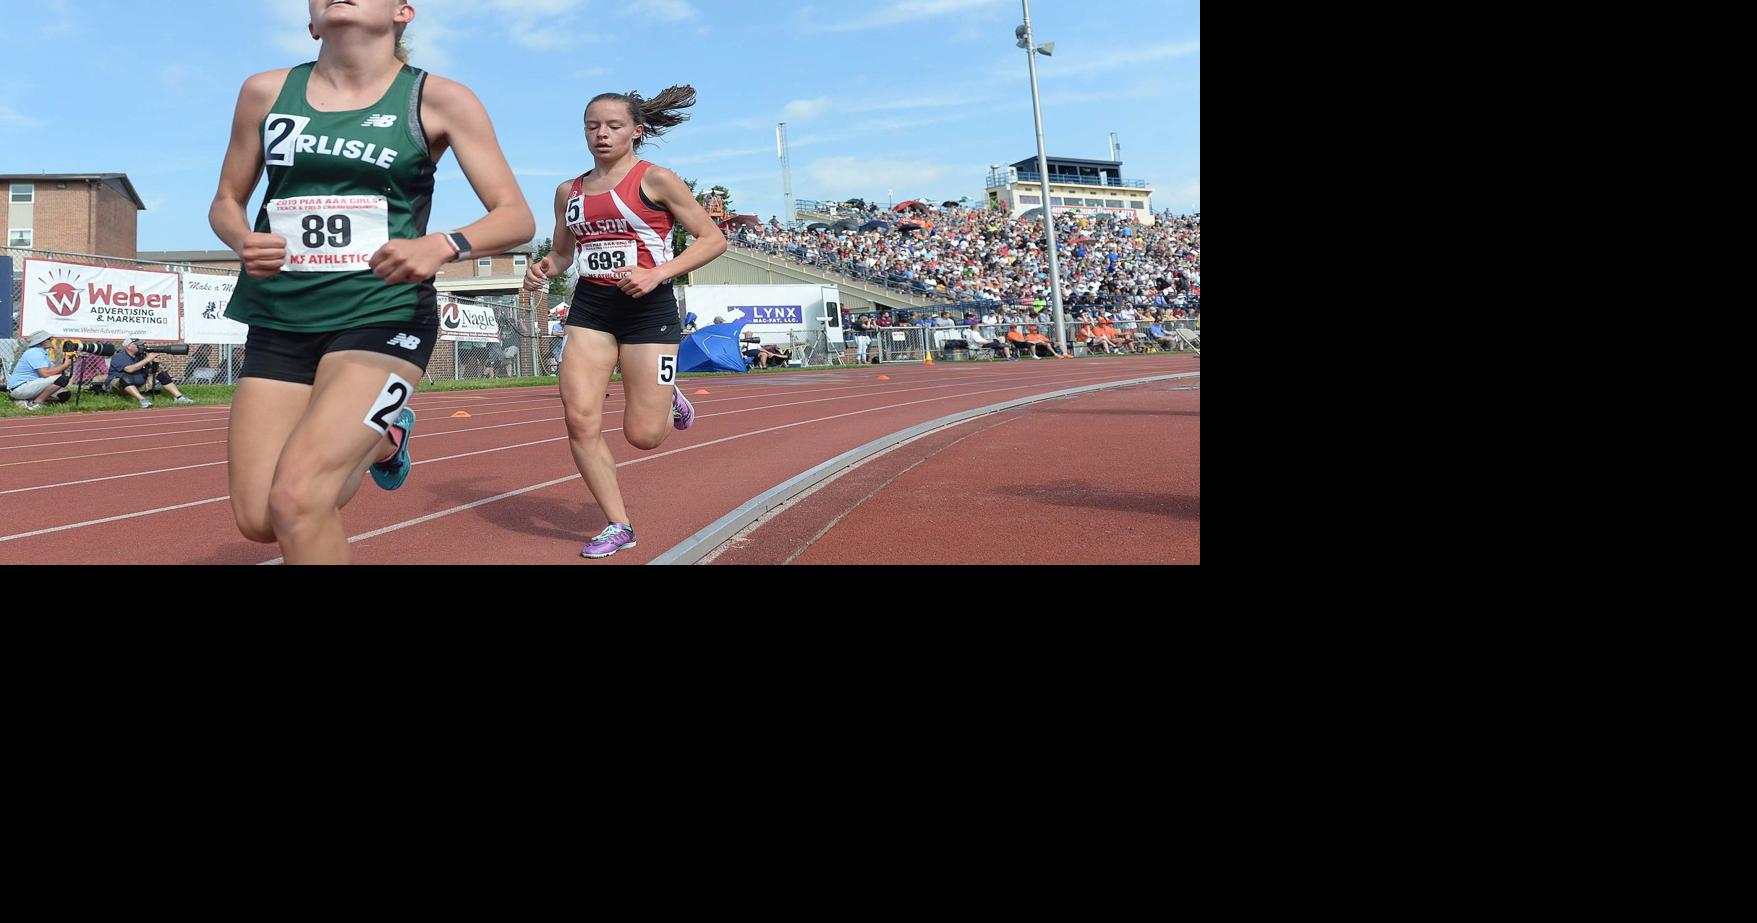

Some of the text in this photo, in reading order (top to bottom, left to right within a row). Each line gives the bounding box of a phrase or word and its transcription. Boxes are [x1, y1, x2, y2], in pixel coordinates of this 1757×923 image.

[268, 117, 295, 160] 2
[295, 134, 398, 169] RLISLE
[568, 197, 580, 222] 5
[302, 214, 352, 248] 89
[569, 219, 628, 236] WILSON
[309, 253, 369, 265] ATHLETIC
[588, 250, 626, 271] 693
[88, 283, 171, 308] Weber
[90, 307, 154, 316] ADVERTISING
[107, 316, 162, 324] MARKETING
[462, 310, 495, 330] Nagle
[753, 307, 797, 318] LYNX
[661, 356, 674, 382] 5
[371, 382, 407, 430] 2
